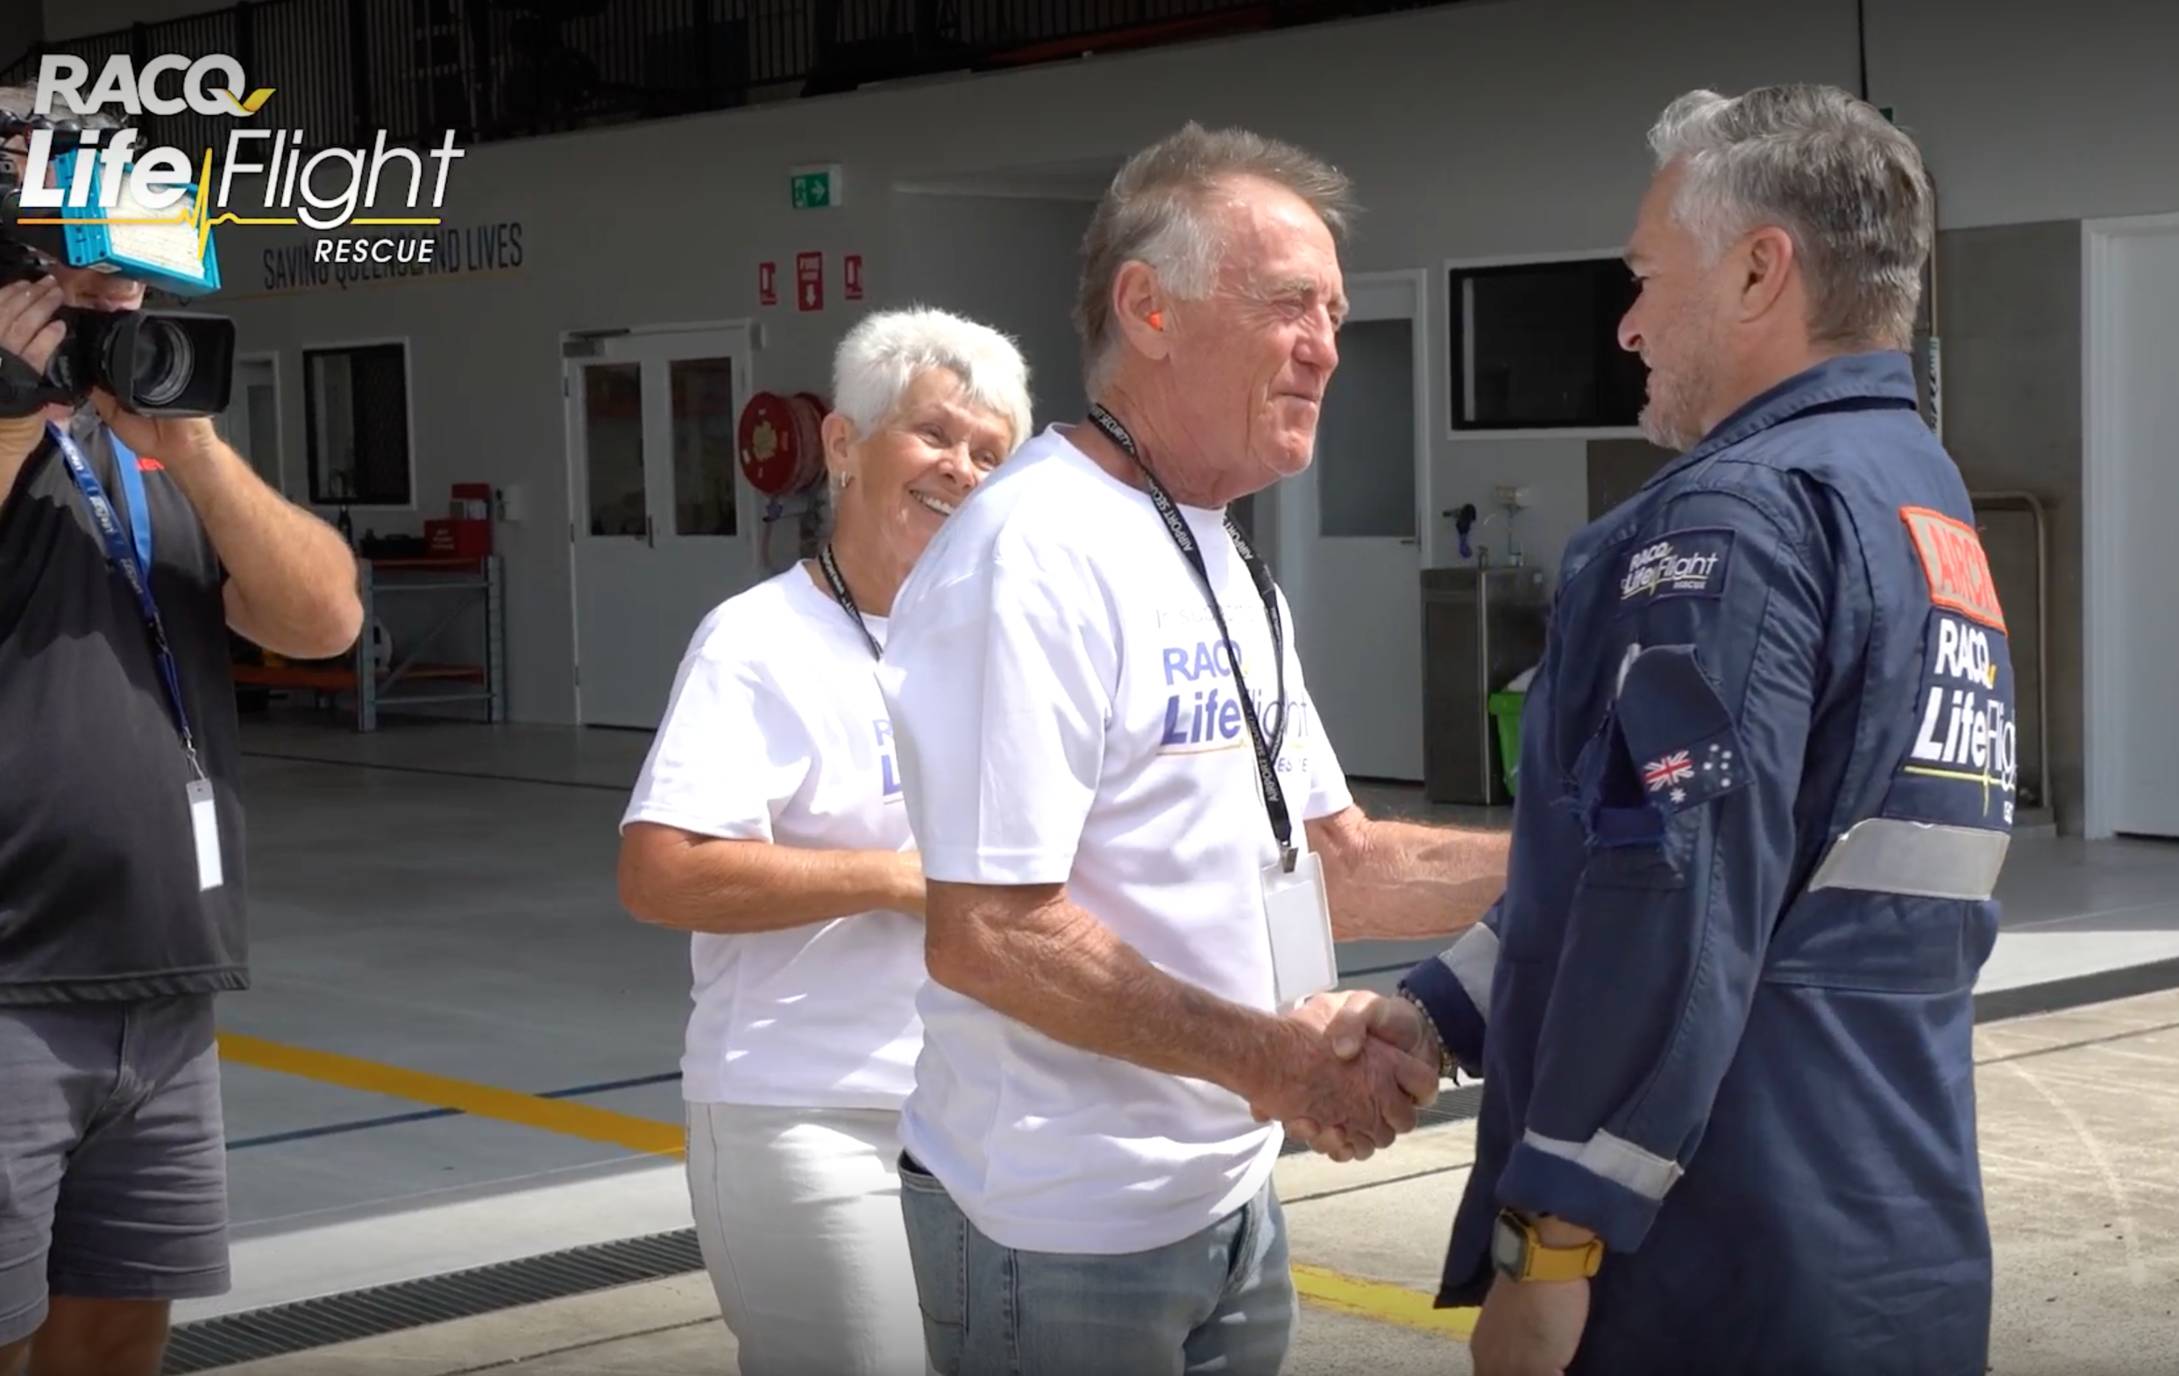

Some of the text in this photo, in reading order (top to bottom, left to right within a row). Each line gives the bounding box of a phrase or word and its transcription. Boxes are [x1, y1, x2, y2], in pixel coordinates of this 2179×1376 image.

[466, 222, 523, 271] LIVES
[1165, 509, 1194, 553] AIRPORT
[1224, 520, 1254, 561] AIRPORT
[1934, 617, 1997, 690] RACQ
